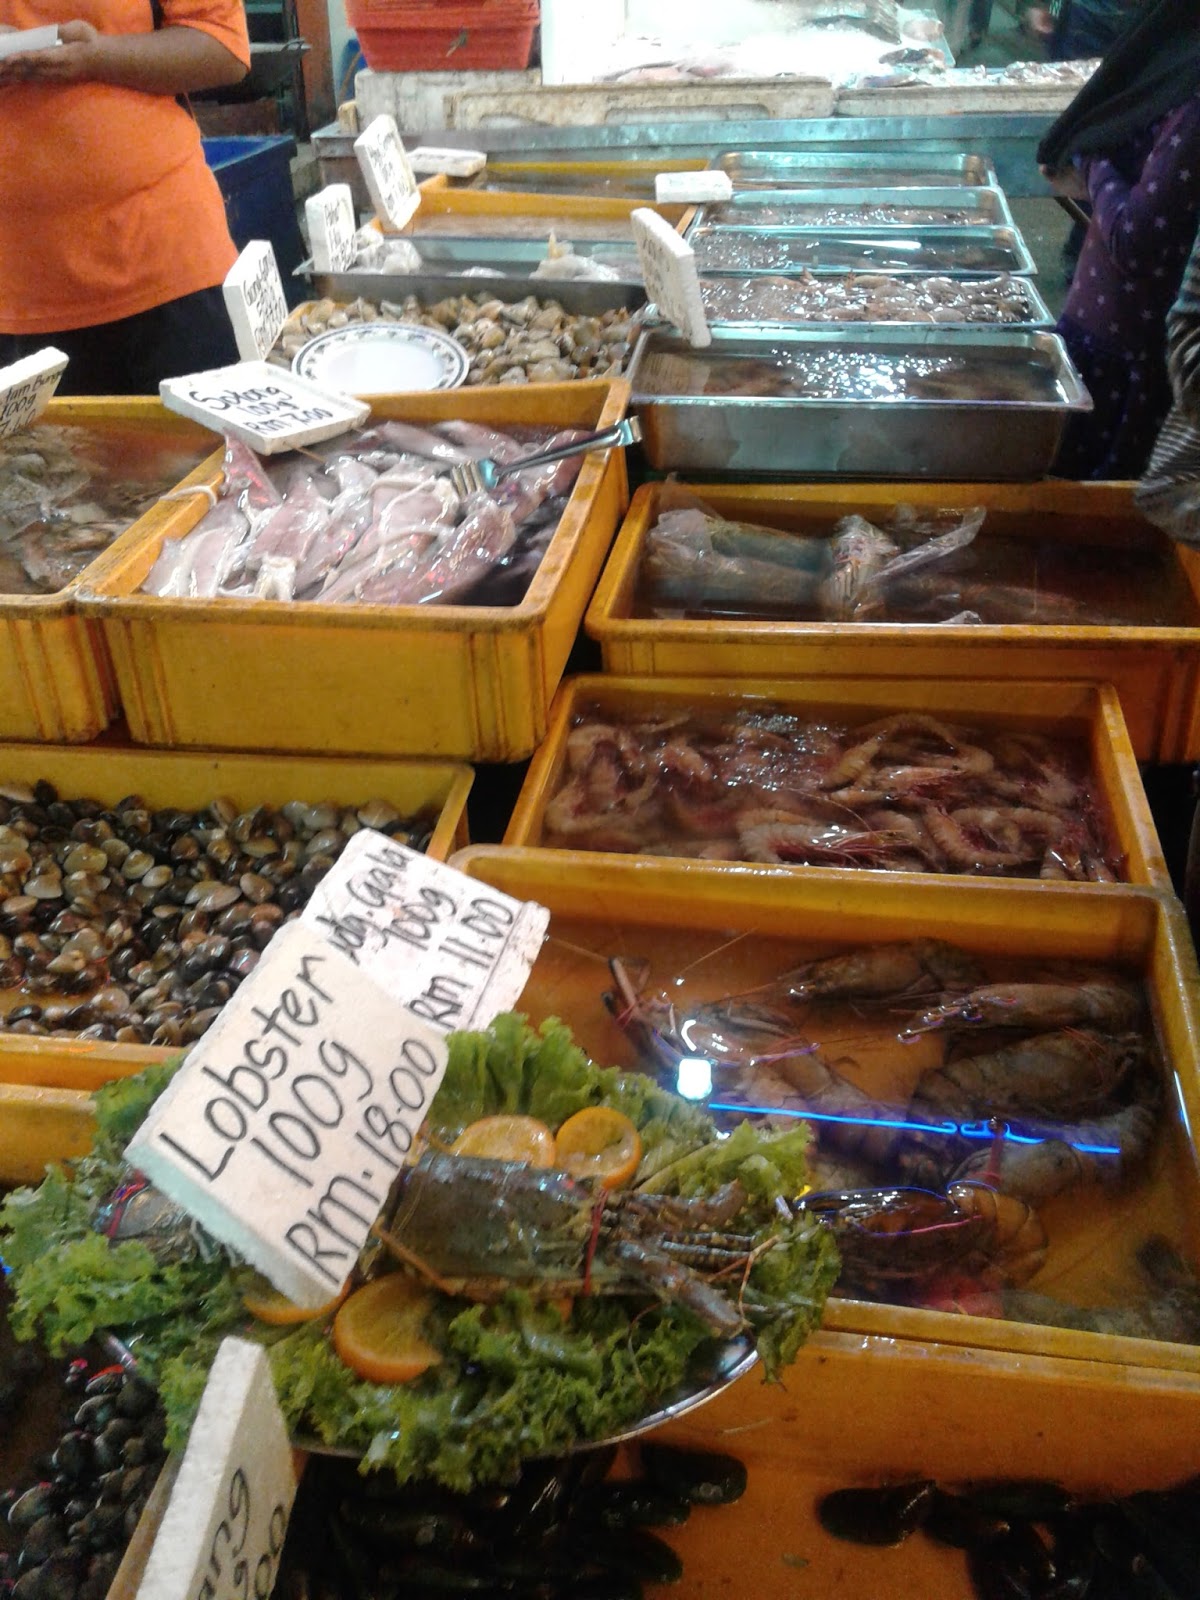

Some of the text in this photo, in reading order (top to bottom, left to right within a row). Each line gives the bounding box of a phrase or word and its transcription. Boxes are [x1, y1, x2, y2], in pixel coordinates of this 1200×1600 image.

[381, 886, 458, 952] 100g
[159, 955, 336, 1183] Lobster
[251, 1039, 374, 1189] 100g
